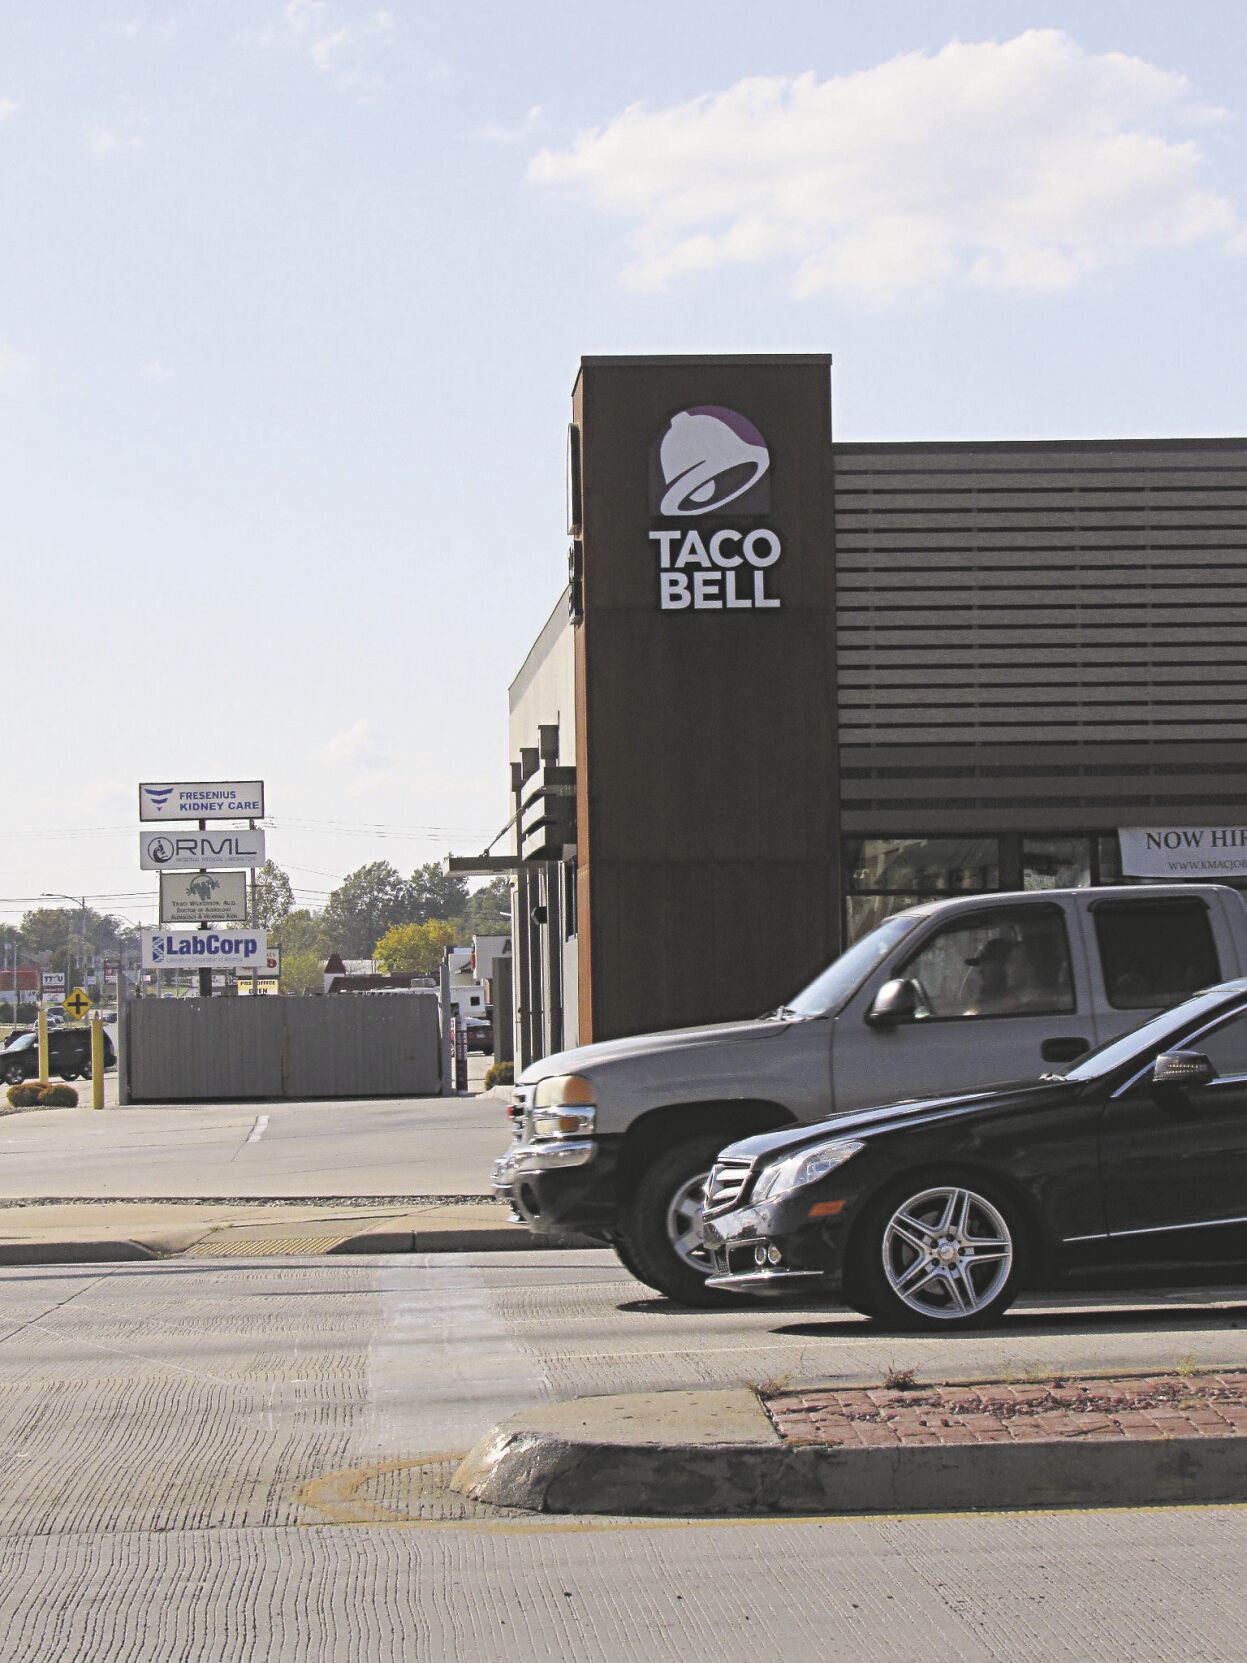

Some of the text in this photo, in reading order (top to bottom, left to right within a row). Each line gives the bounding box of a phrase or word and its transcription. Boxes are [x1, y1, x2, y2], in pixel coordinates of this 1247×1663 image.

[649, 529, 782, 568] TACO
[660, 570, 781, 609] BELL
[179, 791, 236, 800] FRESENIUS
[179, 801, 260, 811] KIDNEY CARE
[176, 838, 258, 856] RML
[1146, 831, 1204, 850] NOW
[166, 934, 258, 958] LabCorp
